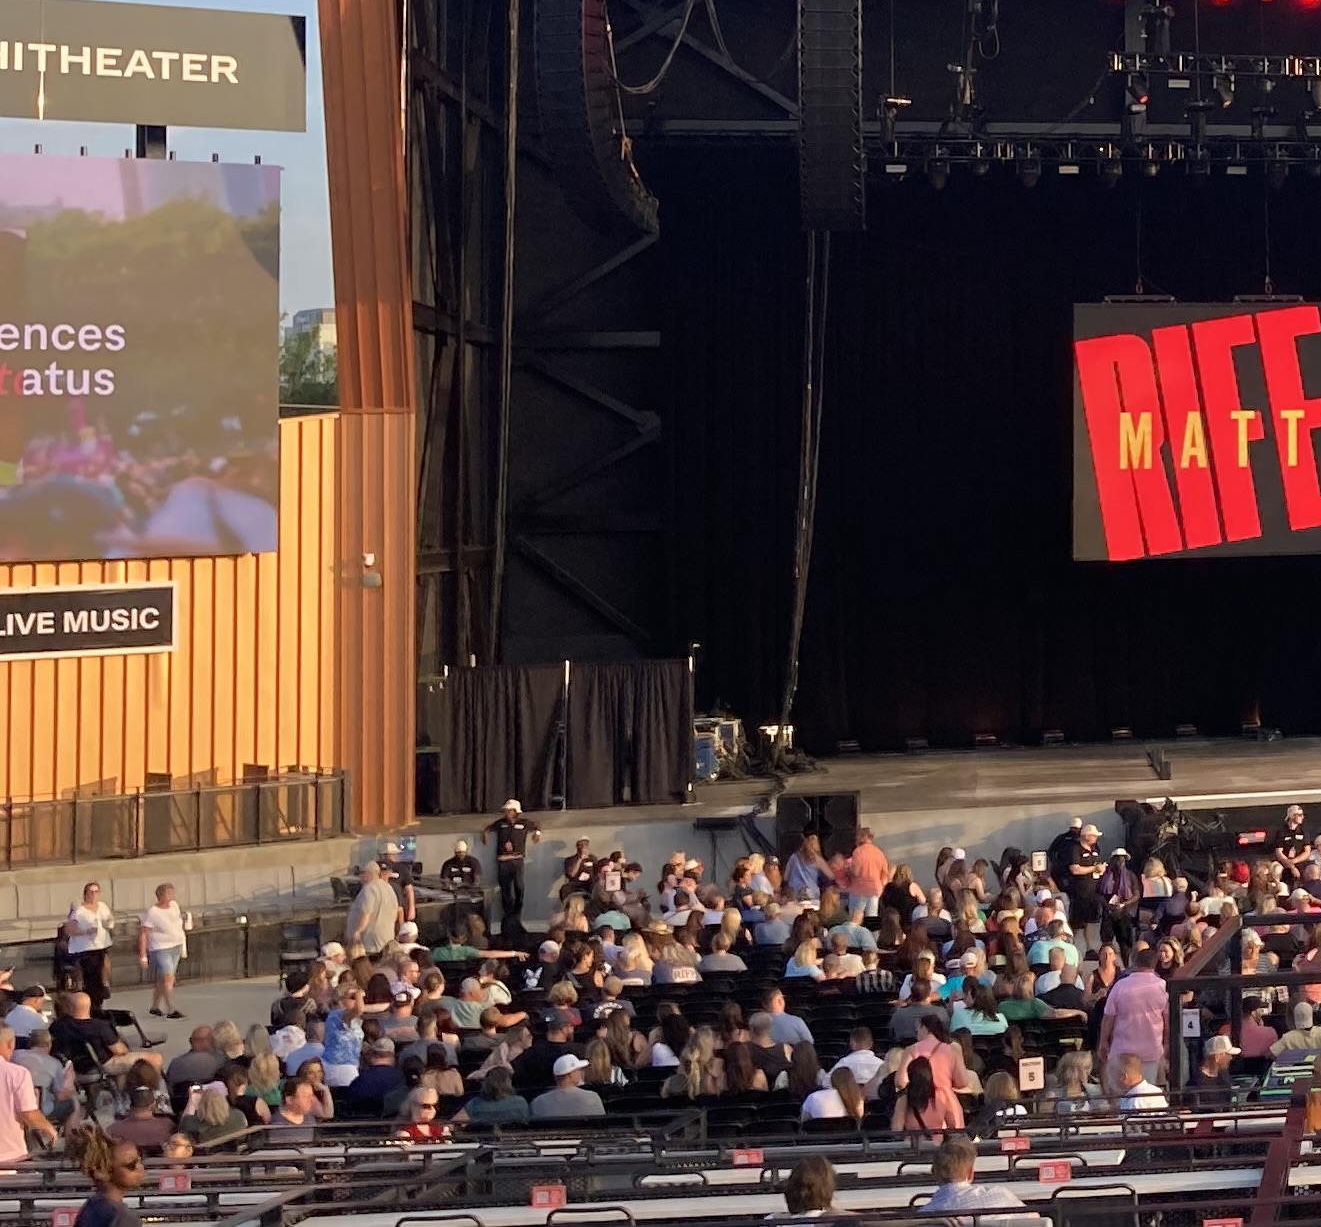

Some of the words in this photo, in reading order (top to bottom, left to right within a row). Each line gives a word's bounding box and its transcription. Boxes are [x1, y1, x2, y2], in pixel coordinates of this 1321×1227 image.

[0, 323, 126, 351] ences
[1119, 409, 1305, 470] MATT
[63, 607, 160, 634] MUSIC
[1028, 1071, 1035, 1082] 5
